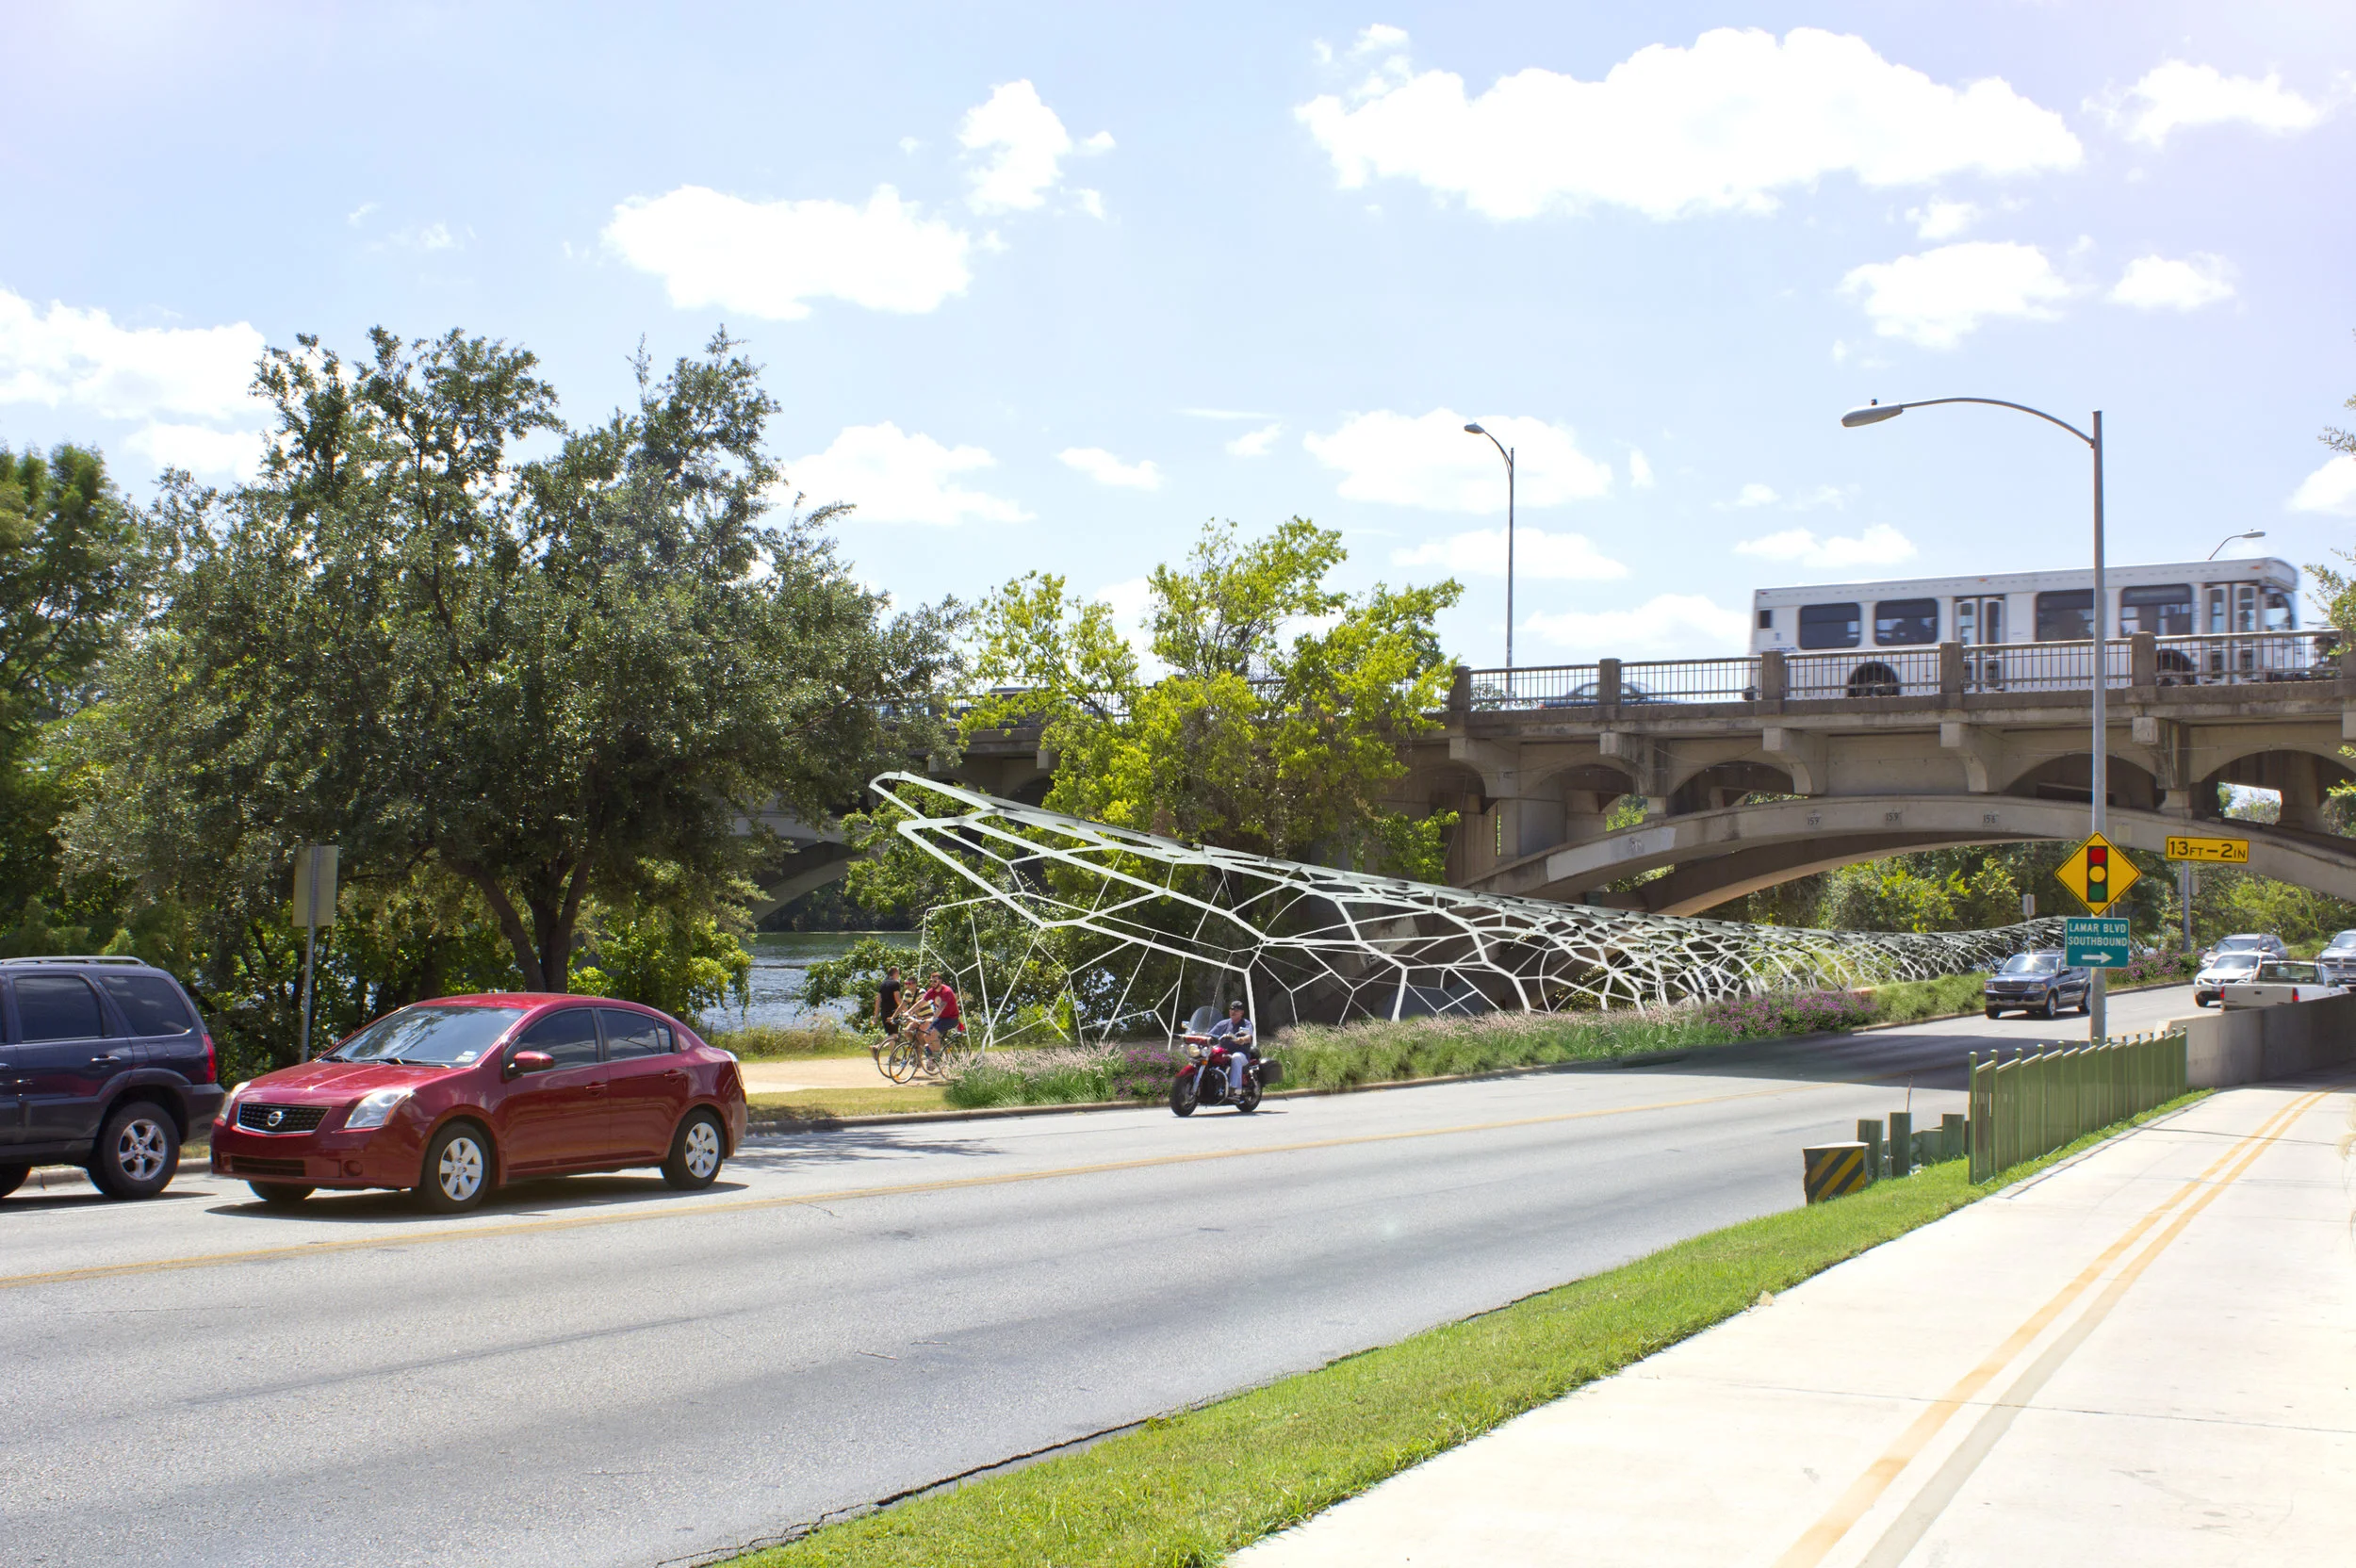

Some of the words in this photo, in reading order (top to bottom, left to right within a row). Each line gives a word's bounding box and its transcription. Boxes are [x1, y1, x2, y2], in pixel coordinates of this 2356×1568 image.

[2069, 923, 2100, 933] LAMAR
[2102, 923, 2127, 933] BLVD
[2068, 936, 2128, 947] SOUTHBOUND
